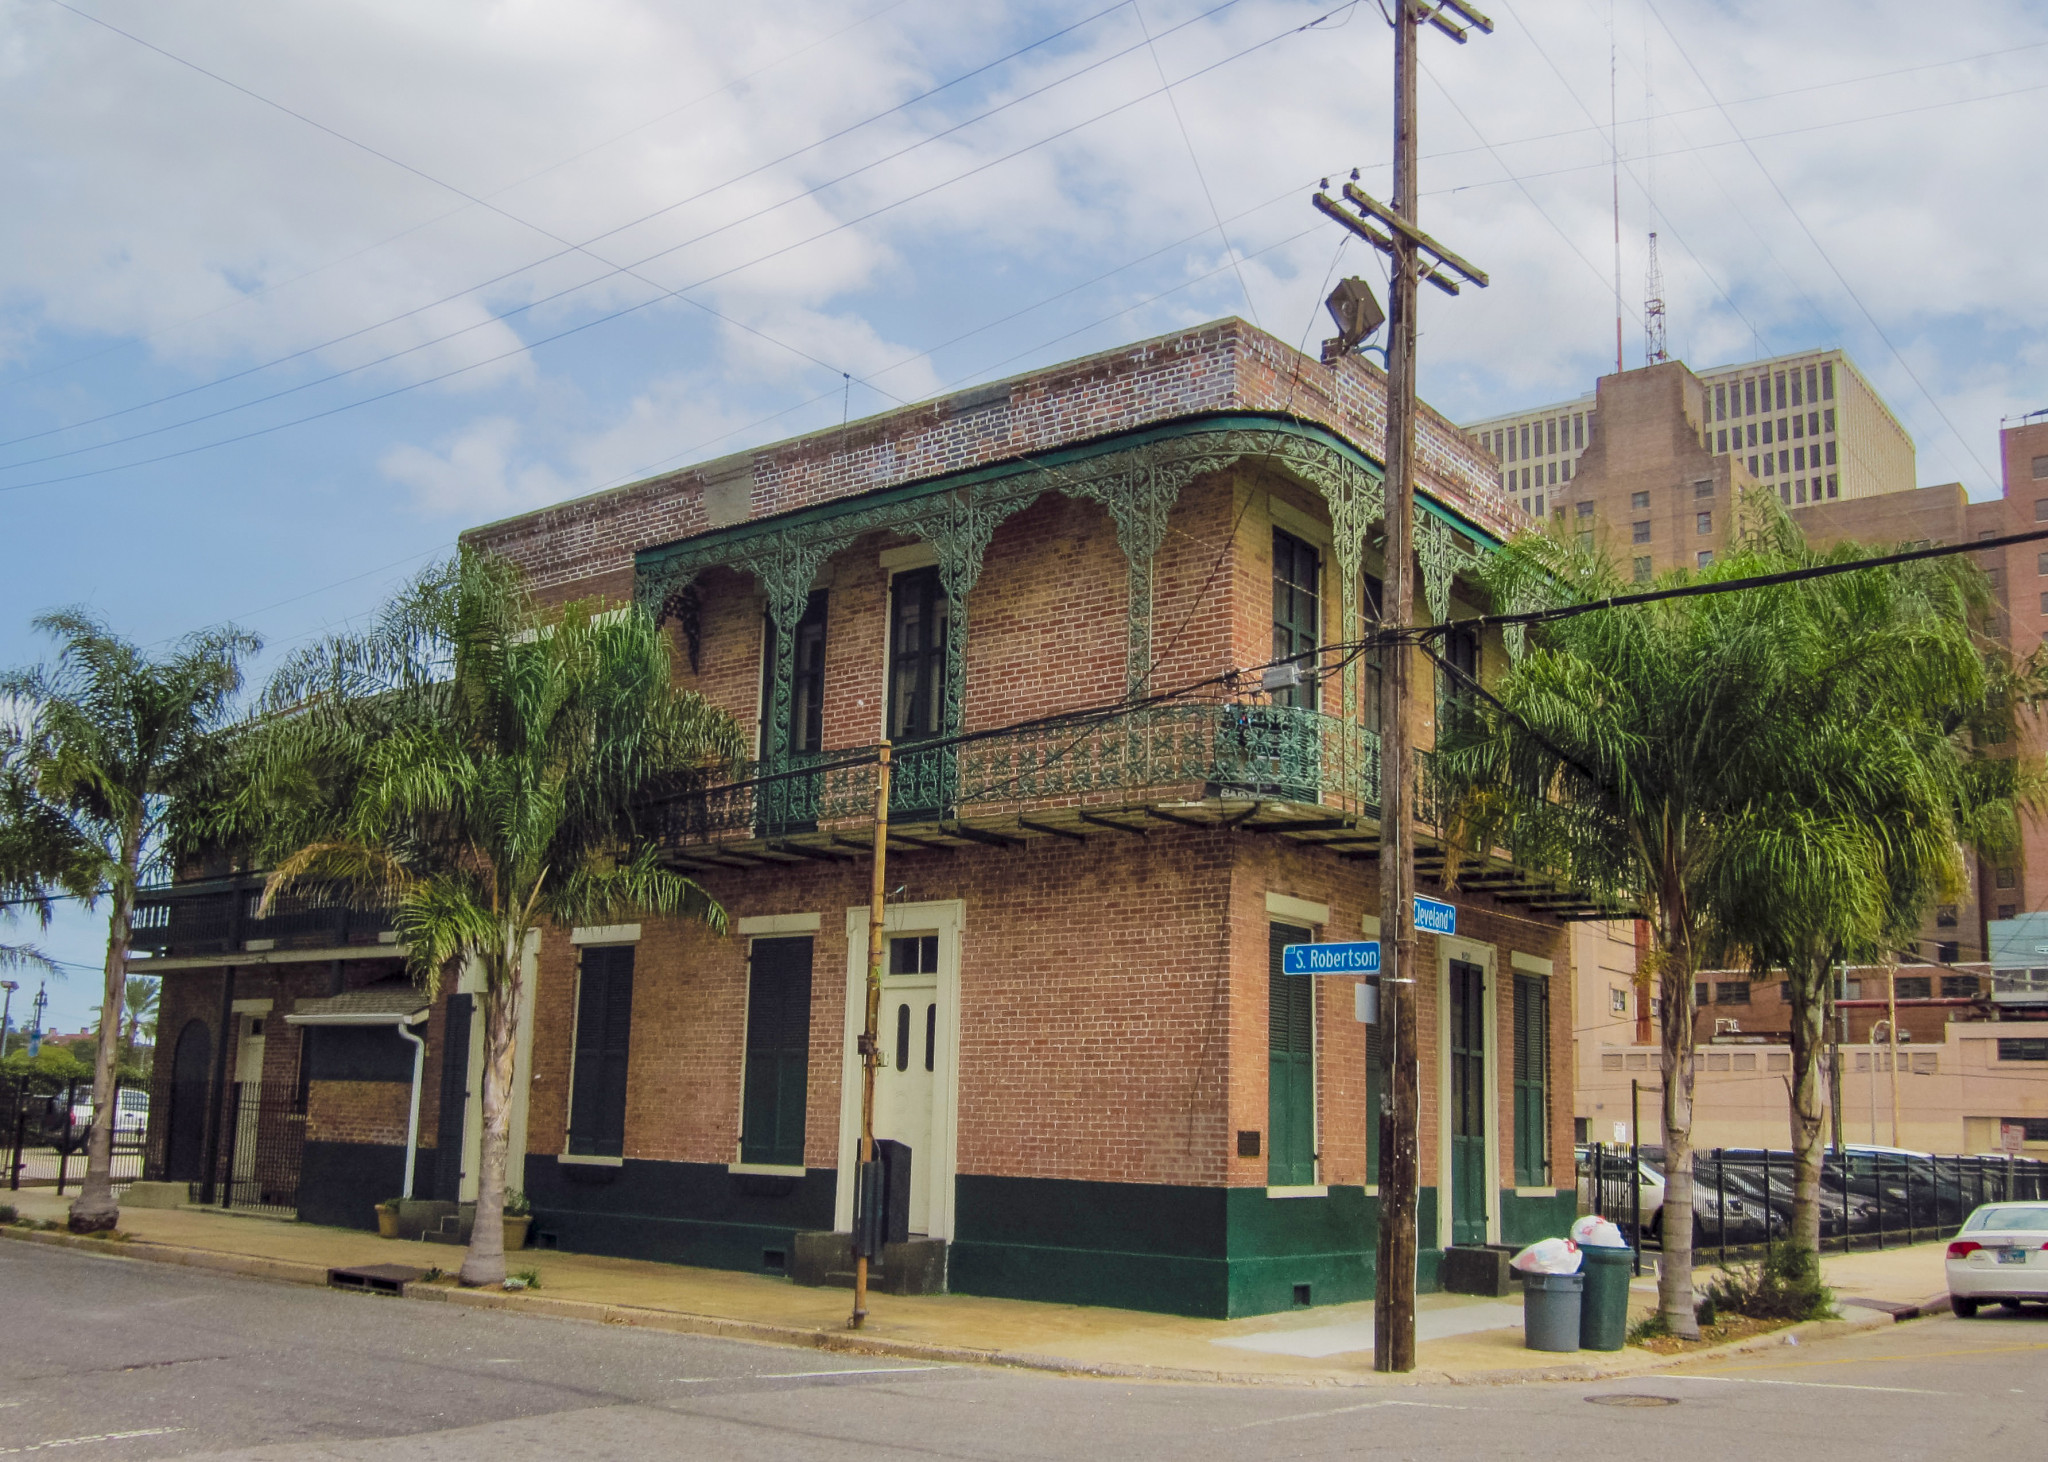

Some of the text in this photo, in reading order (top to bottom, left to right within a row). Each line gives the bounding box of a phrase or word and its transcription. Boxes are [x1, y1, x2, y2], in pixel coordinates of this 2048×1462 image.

[1414, 900, 1448, 930] Cleveland
[1296, 950, 1306, 969] S.
[1310, 947, 1377, 968] Robertson
